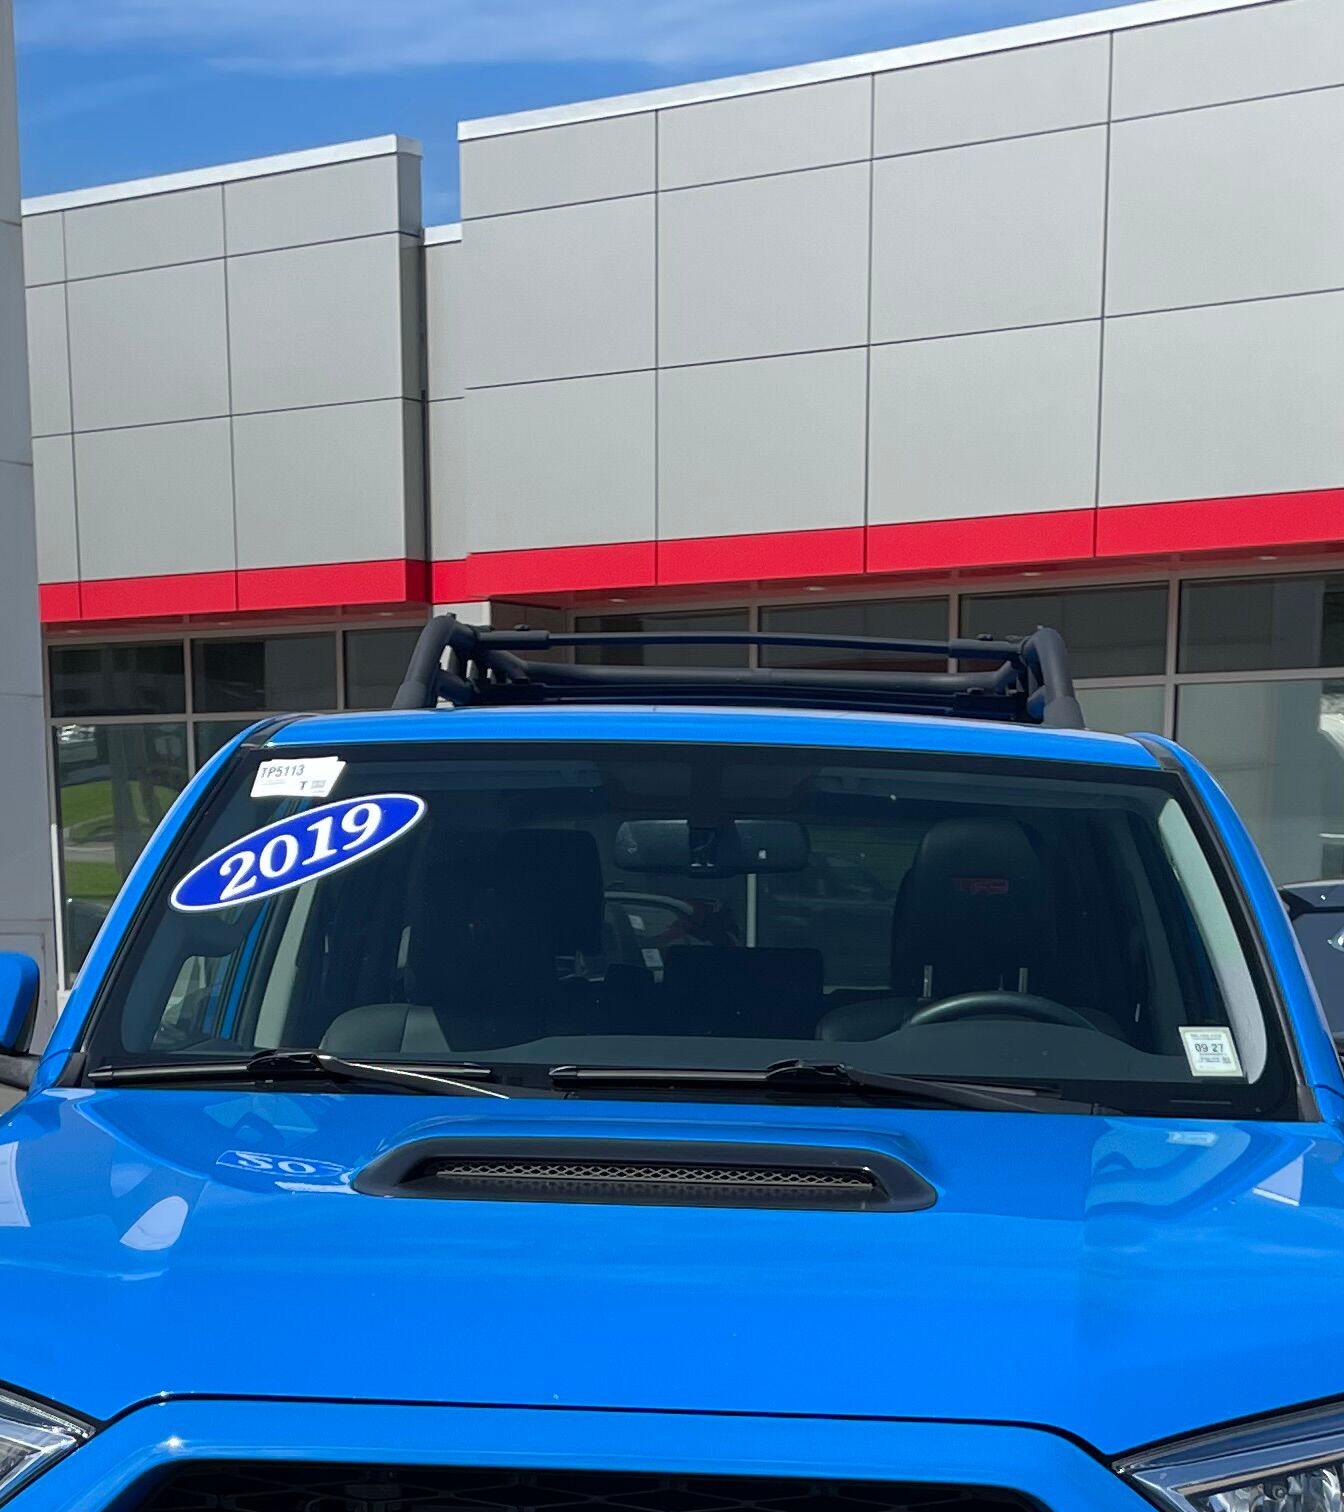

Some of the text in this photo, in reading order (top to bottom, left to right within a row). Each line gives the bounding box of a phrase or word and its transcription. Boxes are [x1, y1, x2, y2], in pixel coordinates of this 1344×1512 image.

[260, 763, 305, 779] TP5113
[218, 802, 383, 901] 2019
[1211, 1043, 1224, 1053] 27
